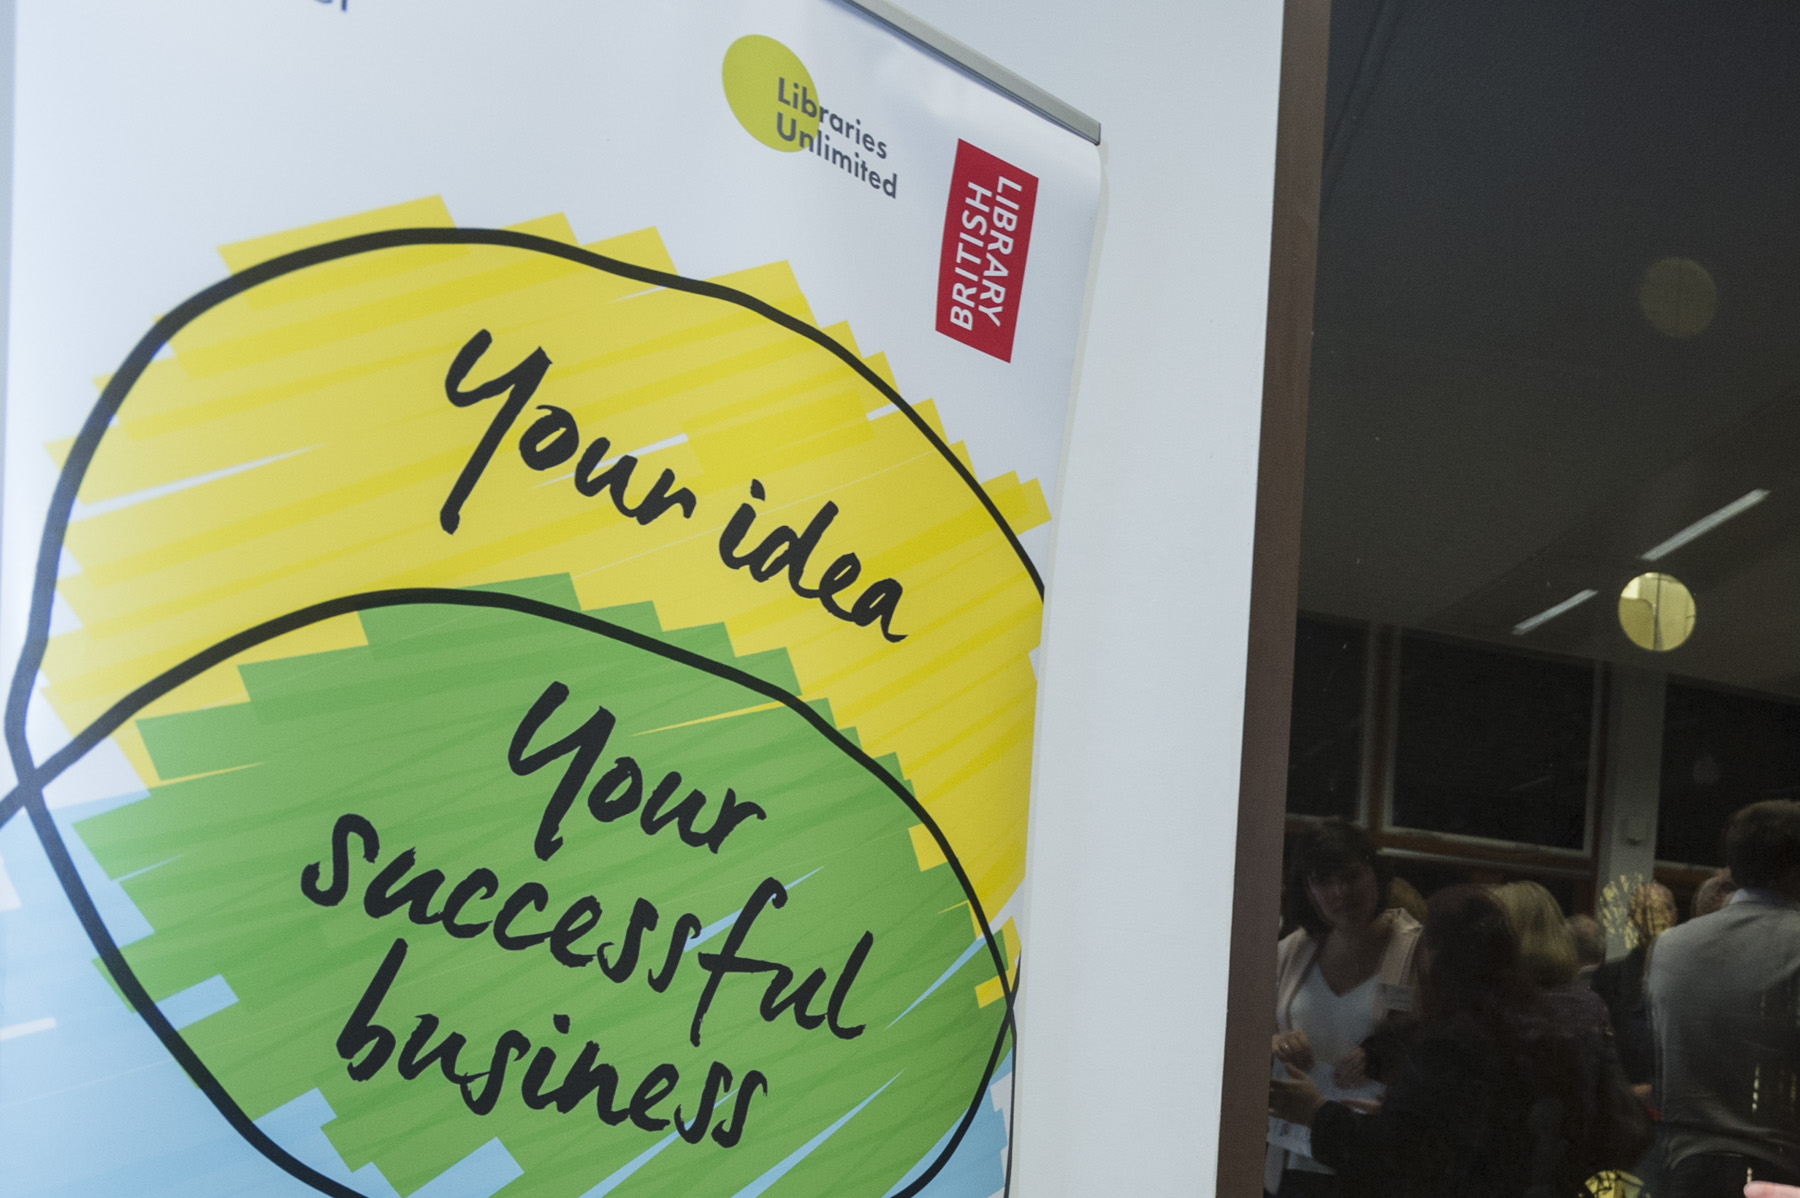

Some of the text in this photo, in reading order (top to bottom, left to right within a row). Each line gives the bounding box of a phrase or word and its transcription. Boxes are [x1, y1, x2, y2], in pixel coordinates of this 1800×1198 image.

[775, 112, 898, 200] Unlimited
[776, 77, 888, 161] Libraries
[949, 181, 991, 332] BRITISH
[978, 173, 1023, 326] LIBRARY
[443, 328, 908, 643] Your idea
[507, 681, 767, 861] Your
[300, 813, 875, 1046] successful
[336, 937, 768, 1148] business
